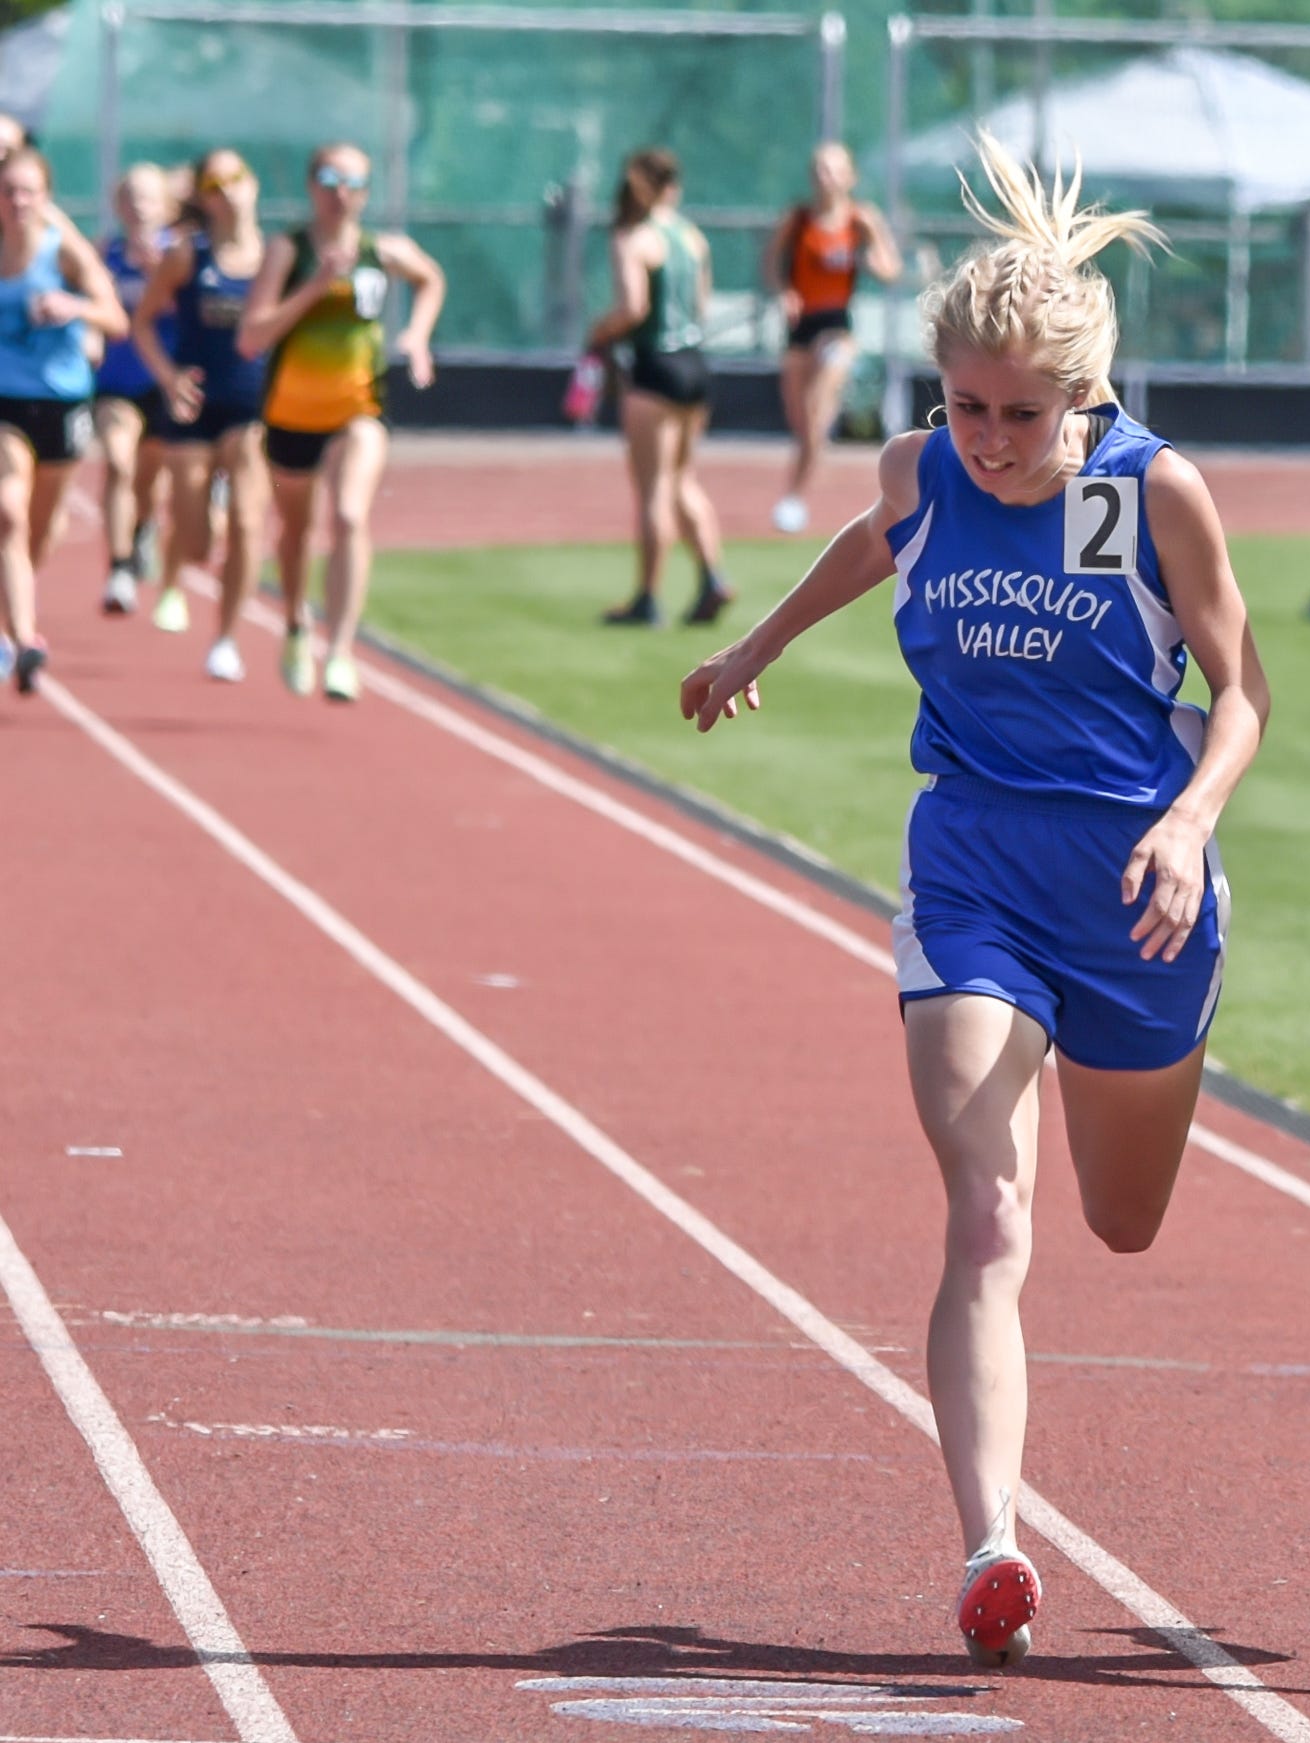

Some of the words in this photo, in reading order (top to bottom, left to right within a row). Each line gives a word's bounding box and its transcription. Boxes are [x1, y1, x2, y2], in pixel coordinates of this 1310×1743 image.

[1079, 482, 1122, 569] 2
[924, 568, 1112, 630] MISSISQUOI
[956, 618, 1063, 662] VALLEY
